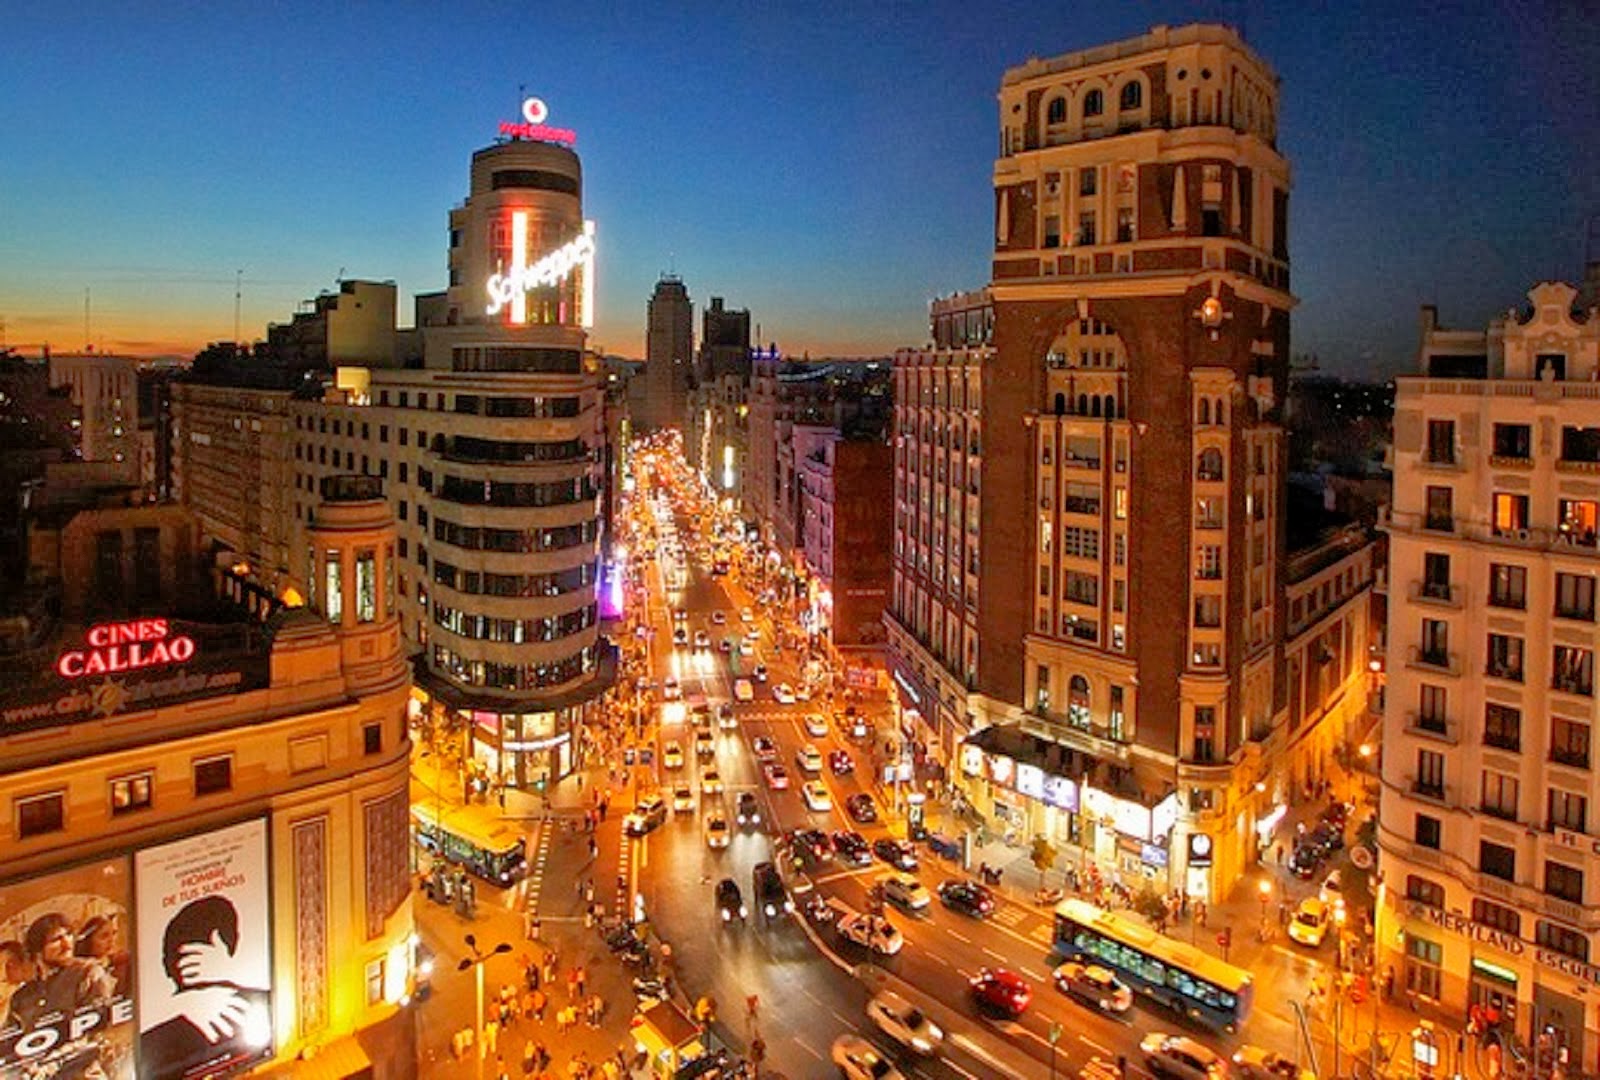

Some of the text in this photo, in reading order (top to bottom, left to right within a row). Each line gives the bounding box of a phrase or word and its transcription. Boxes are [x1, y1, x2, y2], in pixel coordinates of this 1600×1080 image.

[499, 121, 576, 144] vodafone
[486, 231, 595, 316] Schweppes
[88, 618, 168, 647] CINES
[58, 636, 195, 677] CALLAO
[181, 867, 226, 888] HOMBRE
[162, 895, 176, 908] DE
[180, 887, 199, 901] TUS
[1430, 909, 1525, 956] MERYLAND
[0, 998, 134, 1068] OPE
